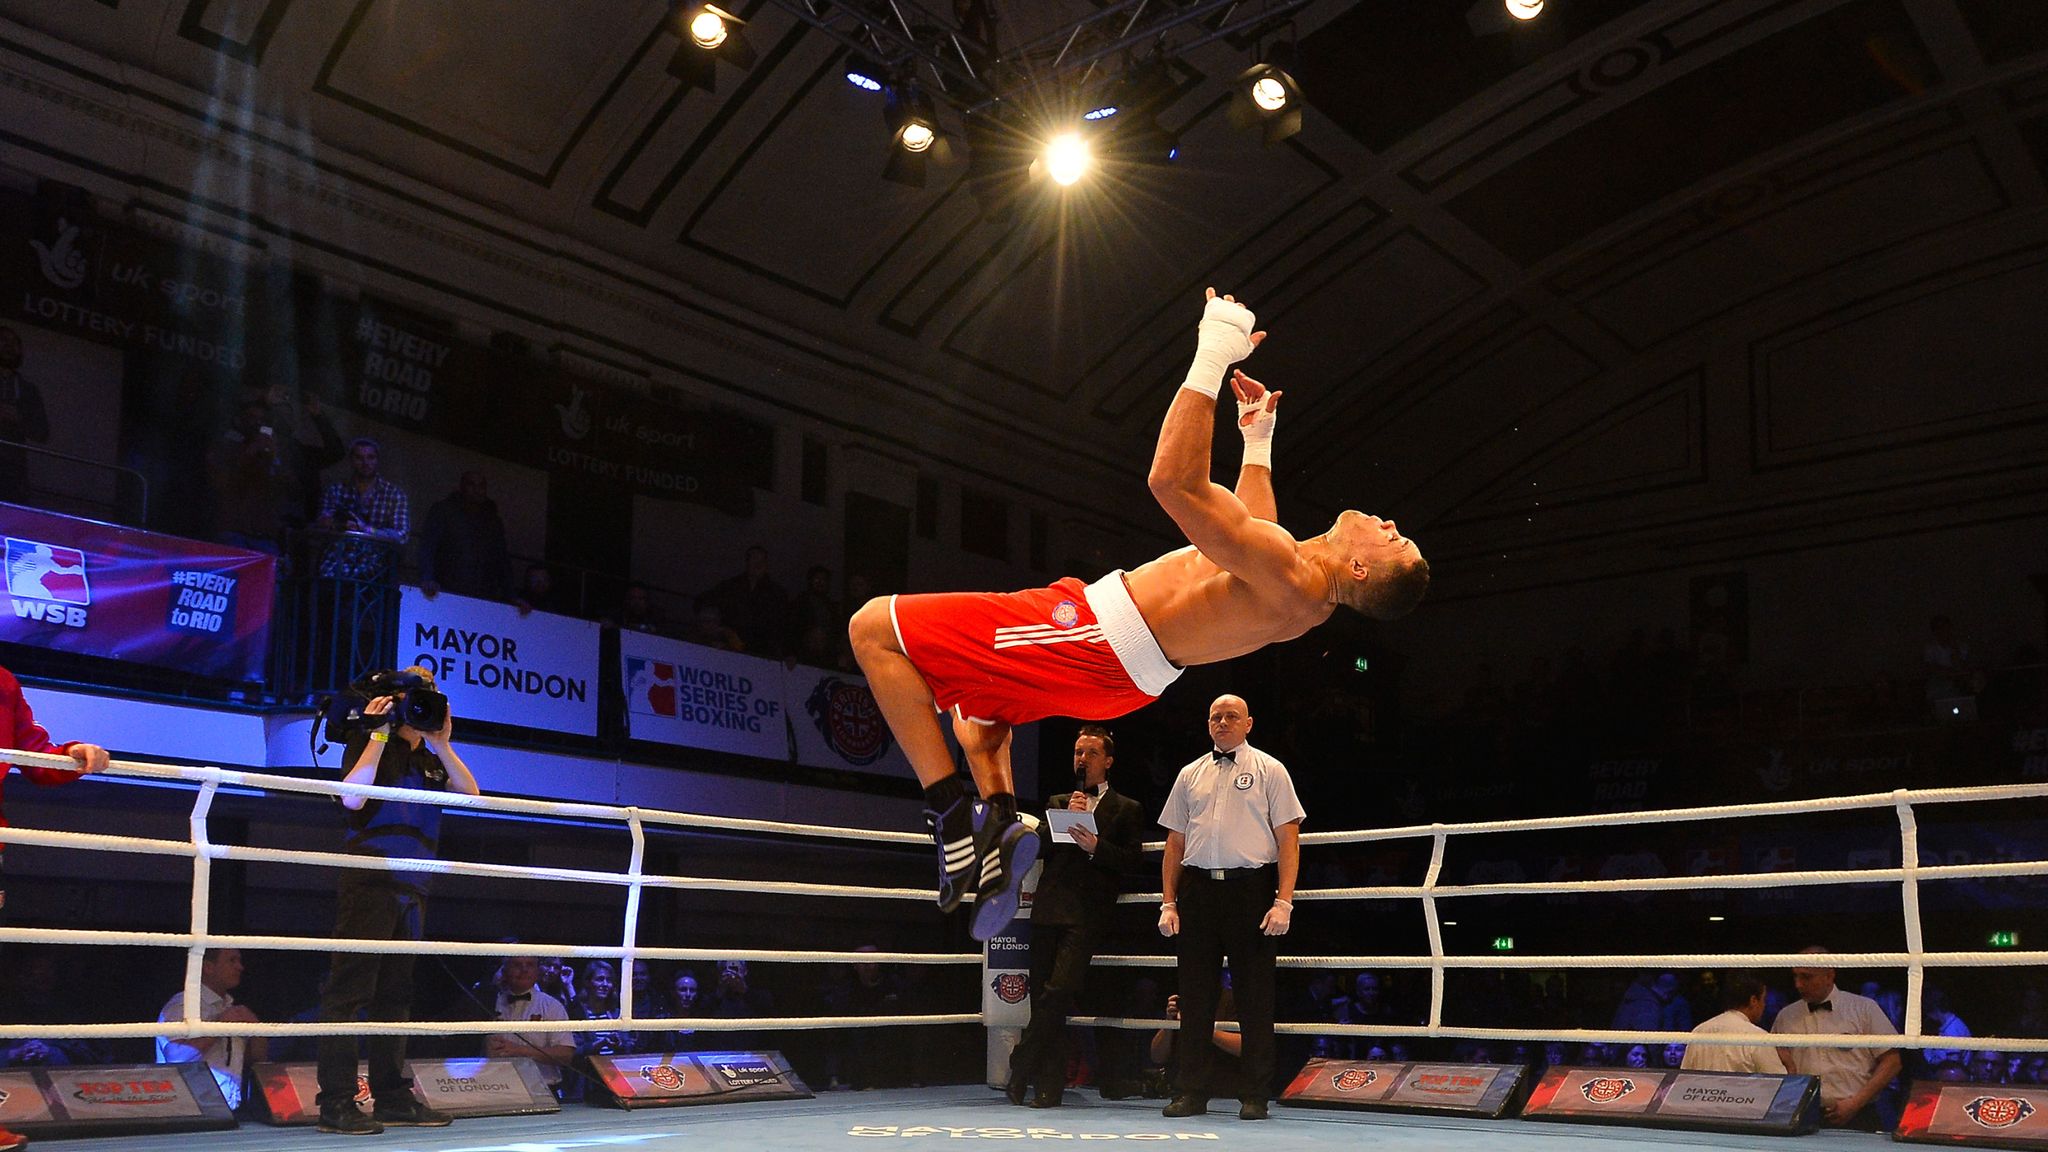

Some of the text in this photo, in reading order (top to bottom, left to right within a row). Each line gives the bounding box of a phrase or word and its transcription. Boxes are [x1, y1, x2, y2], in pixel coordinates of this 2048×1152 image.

[23, 292, 247, 370] LOTTERY FUNDED
[356, 318, 451, 367] #EVERY
[364, 351, 432, 392] ROAD
[547, 446, 699, 493] LOTTERY FUNDED
[172, 570, 237, 595] #EVERY
[11, 599, 88, 628] WSB
[177, 588, 229, 614] ROAD
[415, 623, 518, 663] MAYOR
[464, 660, 586, 702] LONDON
[678, 665, 752, 695] WORLD
[680, 684, 779, 718] SERIES OF
[681, 703, 761, 733] BOXING
[436, 1077, 475, 1085] MAYOR
[440, 1083, 510, 1093] OF LONDON
[1686, 1087, 1728, 1096] MAYOR
[1701, 1095, 1755, 1104] LONDON
[852, 1126, 1057, 1134] MAYOR
[950, 1131, 1220, 1140] LONDON
